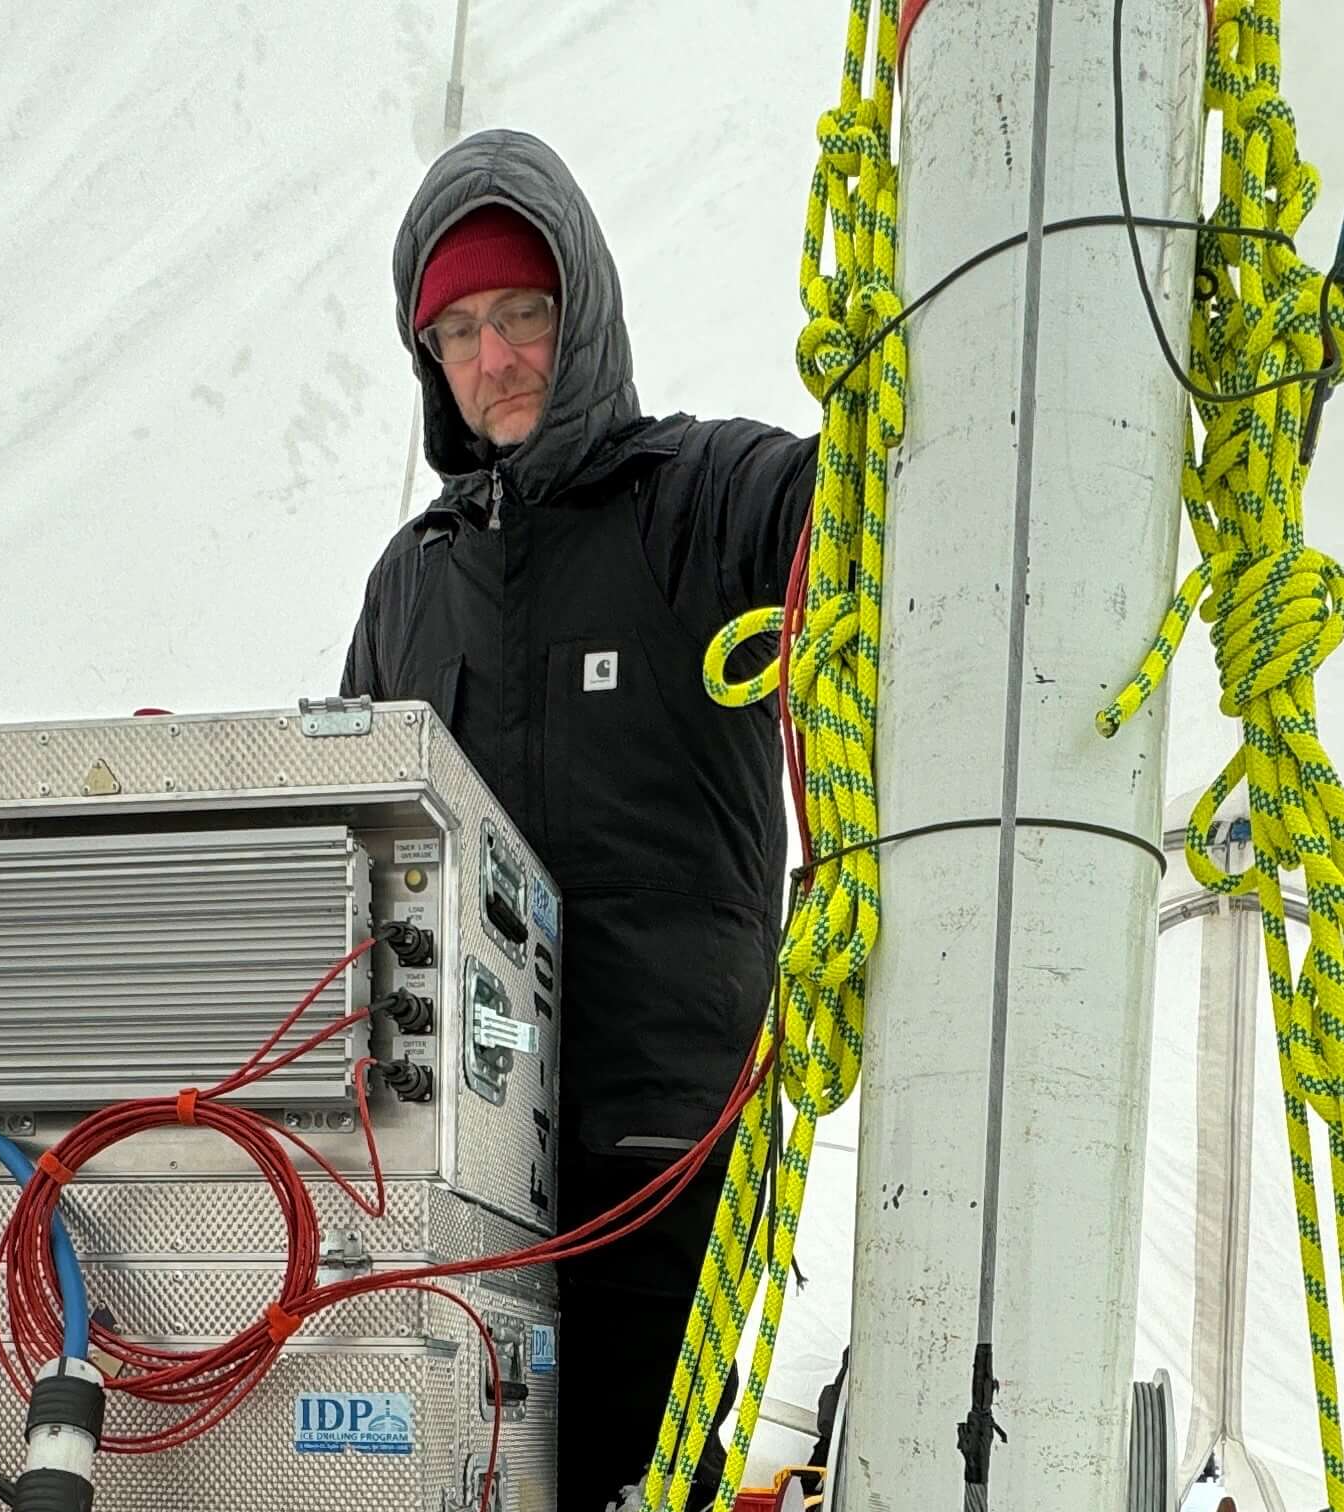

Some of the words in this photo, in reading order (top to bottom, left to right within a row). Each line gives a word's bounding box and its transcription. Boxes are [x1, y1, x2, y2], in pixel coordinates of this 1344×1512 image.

[300, 1398, 373, 1432] IDP
[300, 1432, 314, 1441] ICE
[316, 1432, 357, 1441] DRILLING
[360, 1432, 409, 1442] PROGRAM
